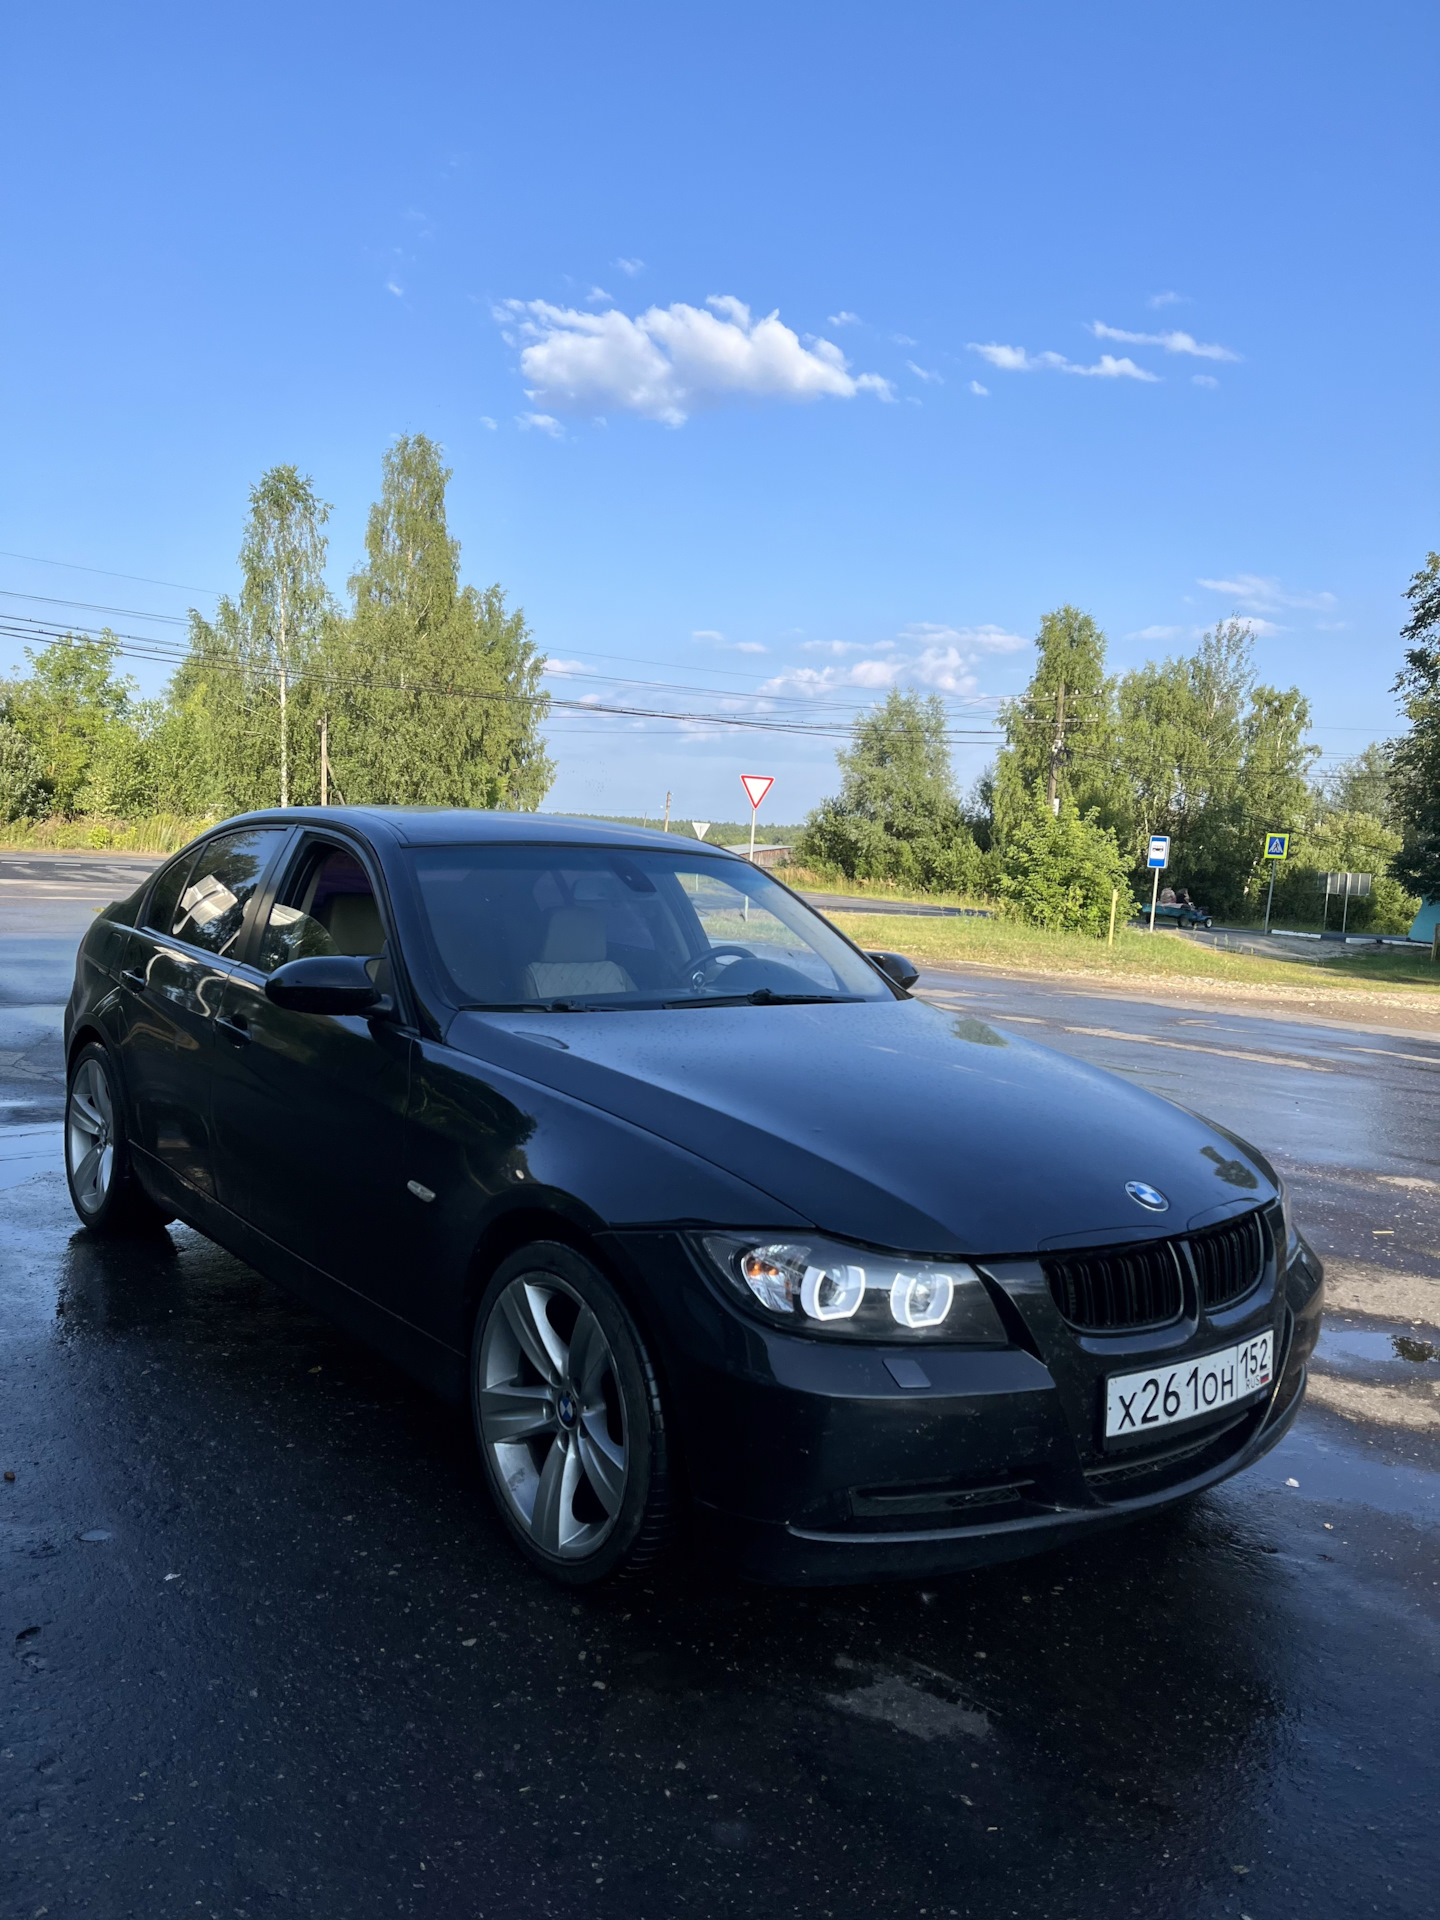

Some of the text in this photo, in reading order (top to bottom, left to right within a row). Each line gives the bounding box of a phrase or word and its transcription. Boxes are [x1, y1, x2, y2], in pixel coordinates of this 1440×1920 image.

[1118, 1338, 1268, 1430] Х261ОН 152
[1245, 1374, 1260, 1391] RUS
